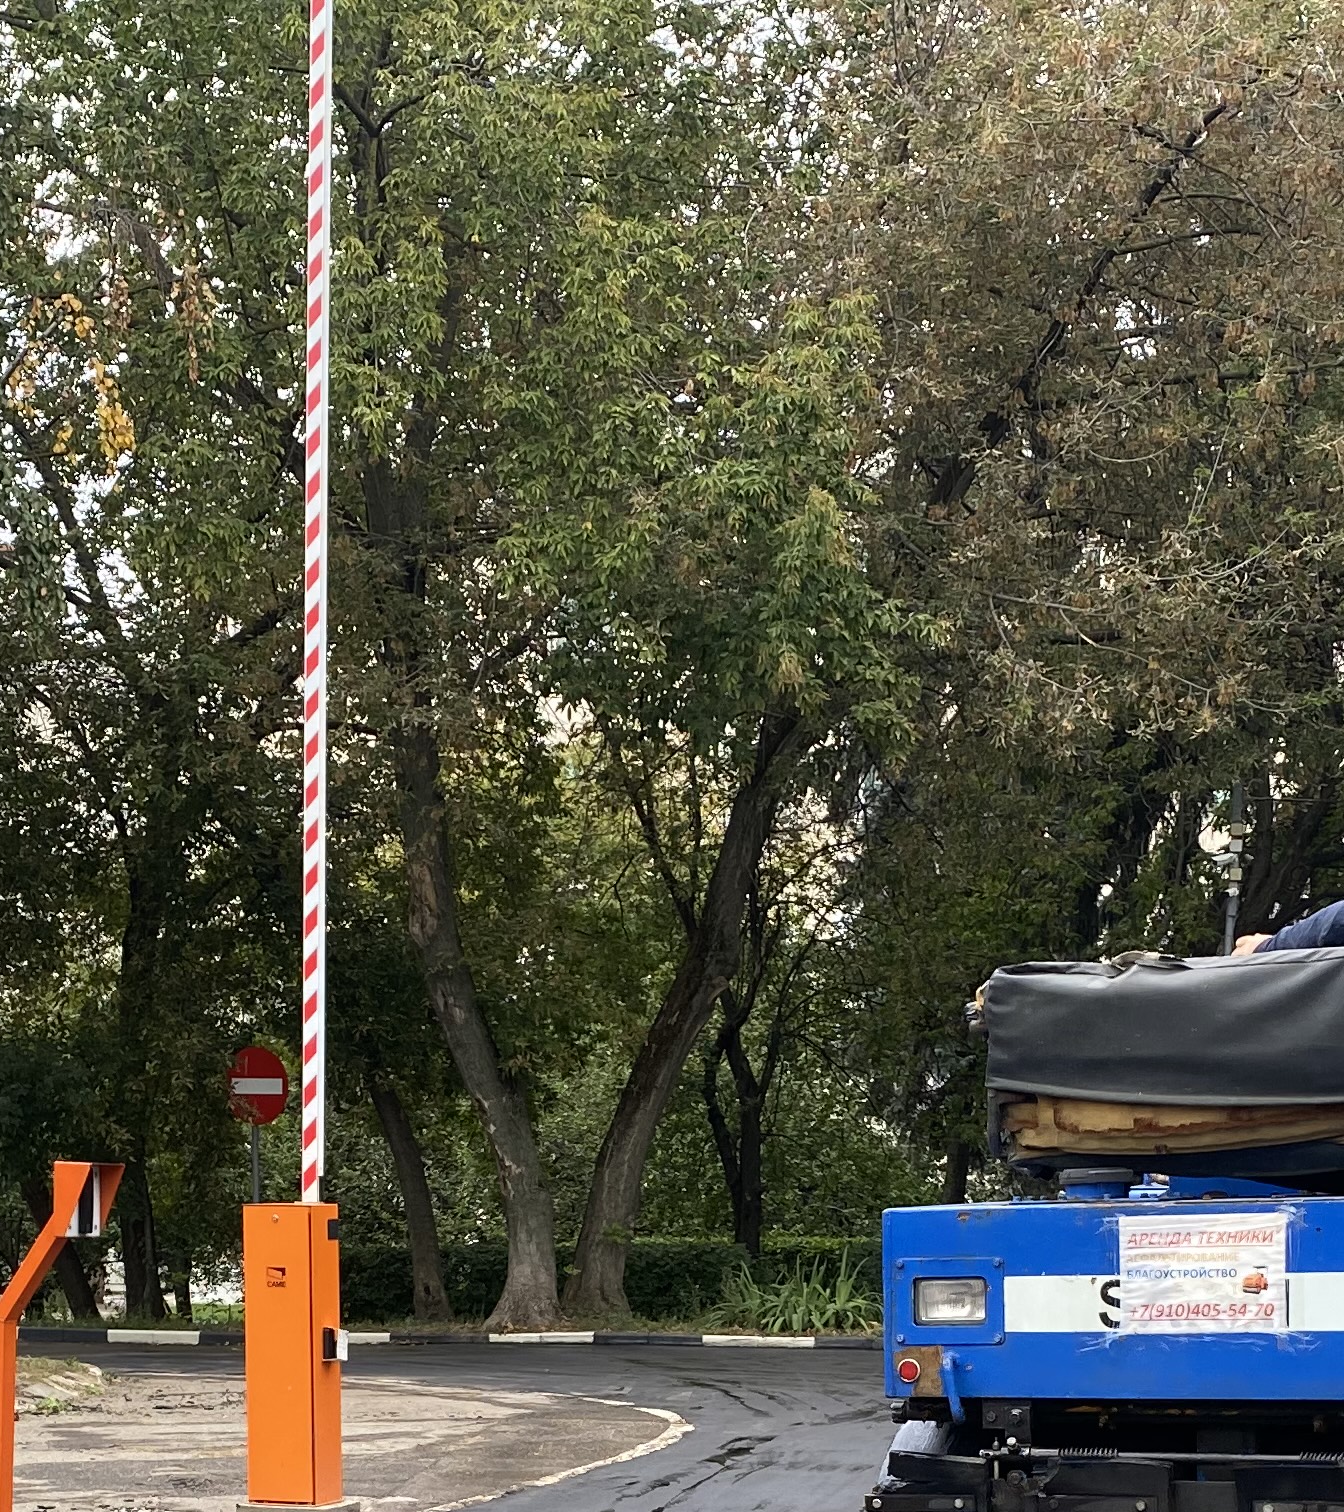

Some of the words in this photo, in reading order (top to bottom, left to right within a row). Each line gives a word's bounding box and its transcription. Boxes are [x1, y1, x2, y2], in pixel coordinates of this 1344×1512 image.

[1127, 1231, 1192, 1247] АРЕНДА
[1197, 1229, 1274, 1245] ТЕХНИКИ
[1127, 1267, 1238, 1279] БЛАГОУСТРОЙСТВО
[1130, 1303, 1275, 1320] +7(910)405-54-70
